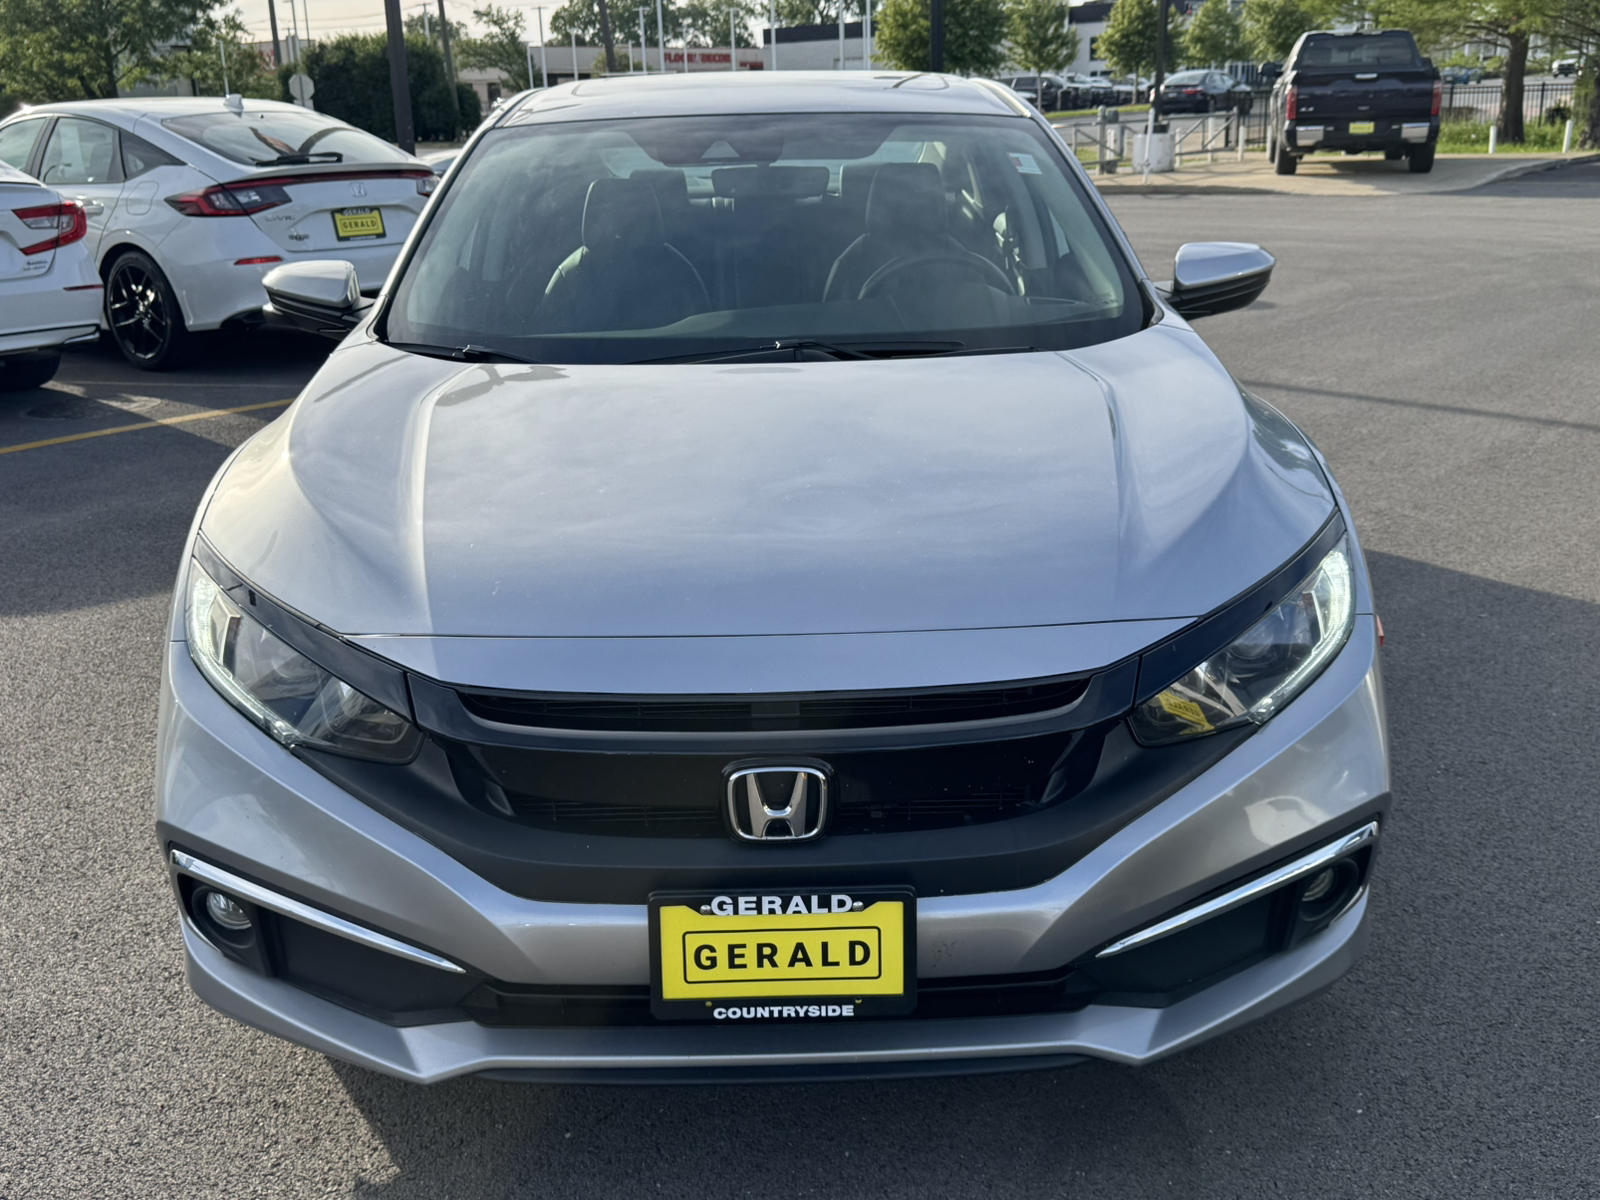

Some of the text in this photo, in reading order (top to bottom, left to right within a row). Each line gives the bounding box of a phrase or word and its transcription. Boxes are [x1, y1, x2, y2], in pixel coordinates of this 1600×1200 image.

[342, 220, 377, 230] GERALD
[711, 894, 853, 916] GERALD
[693, 940, 871, 970] GERALD
[713, 1005, 854, 1020] COUNTRYSIDE
